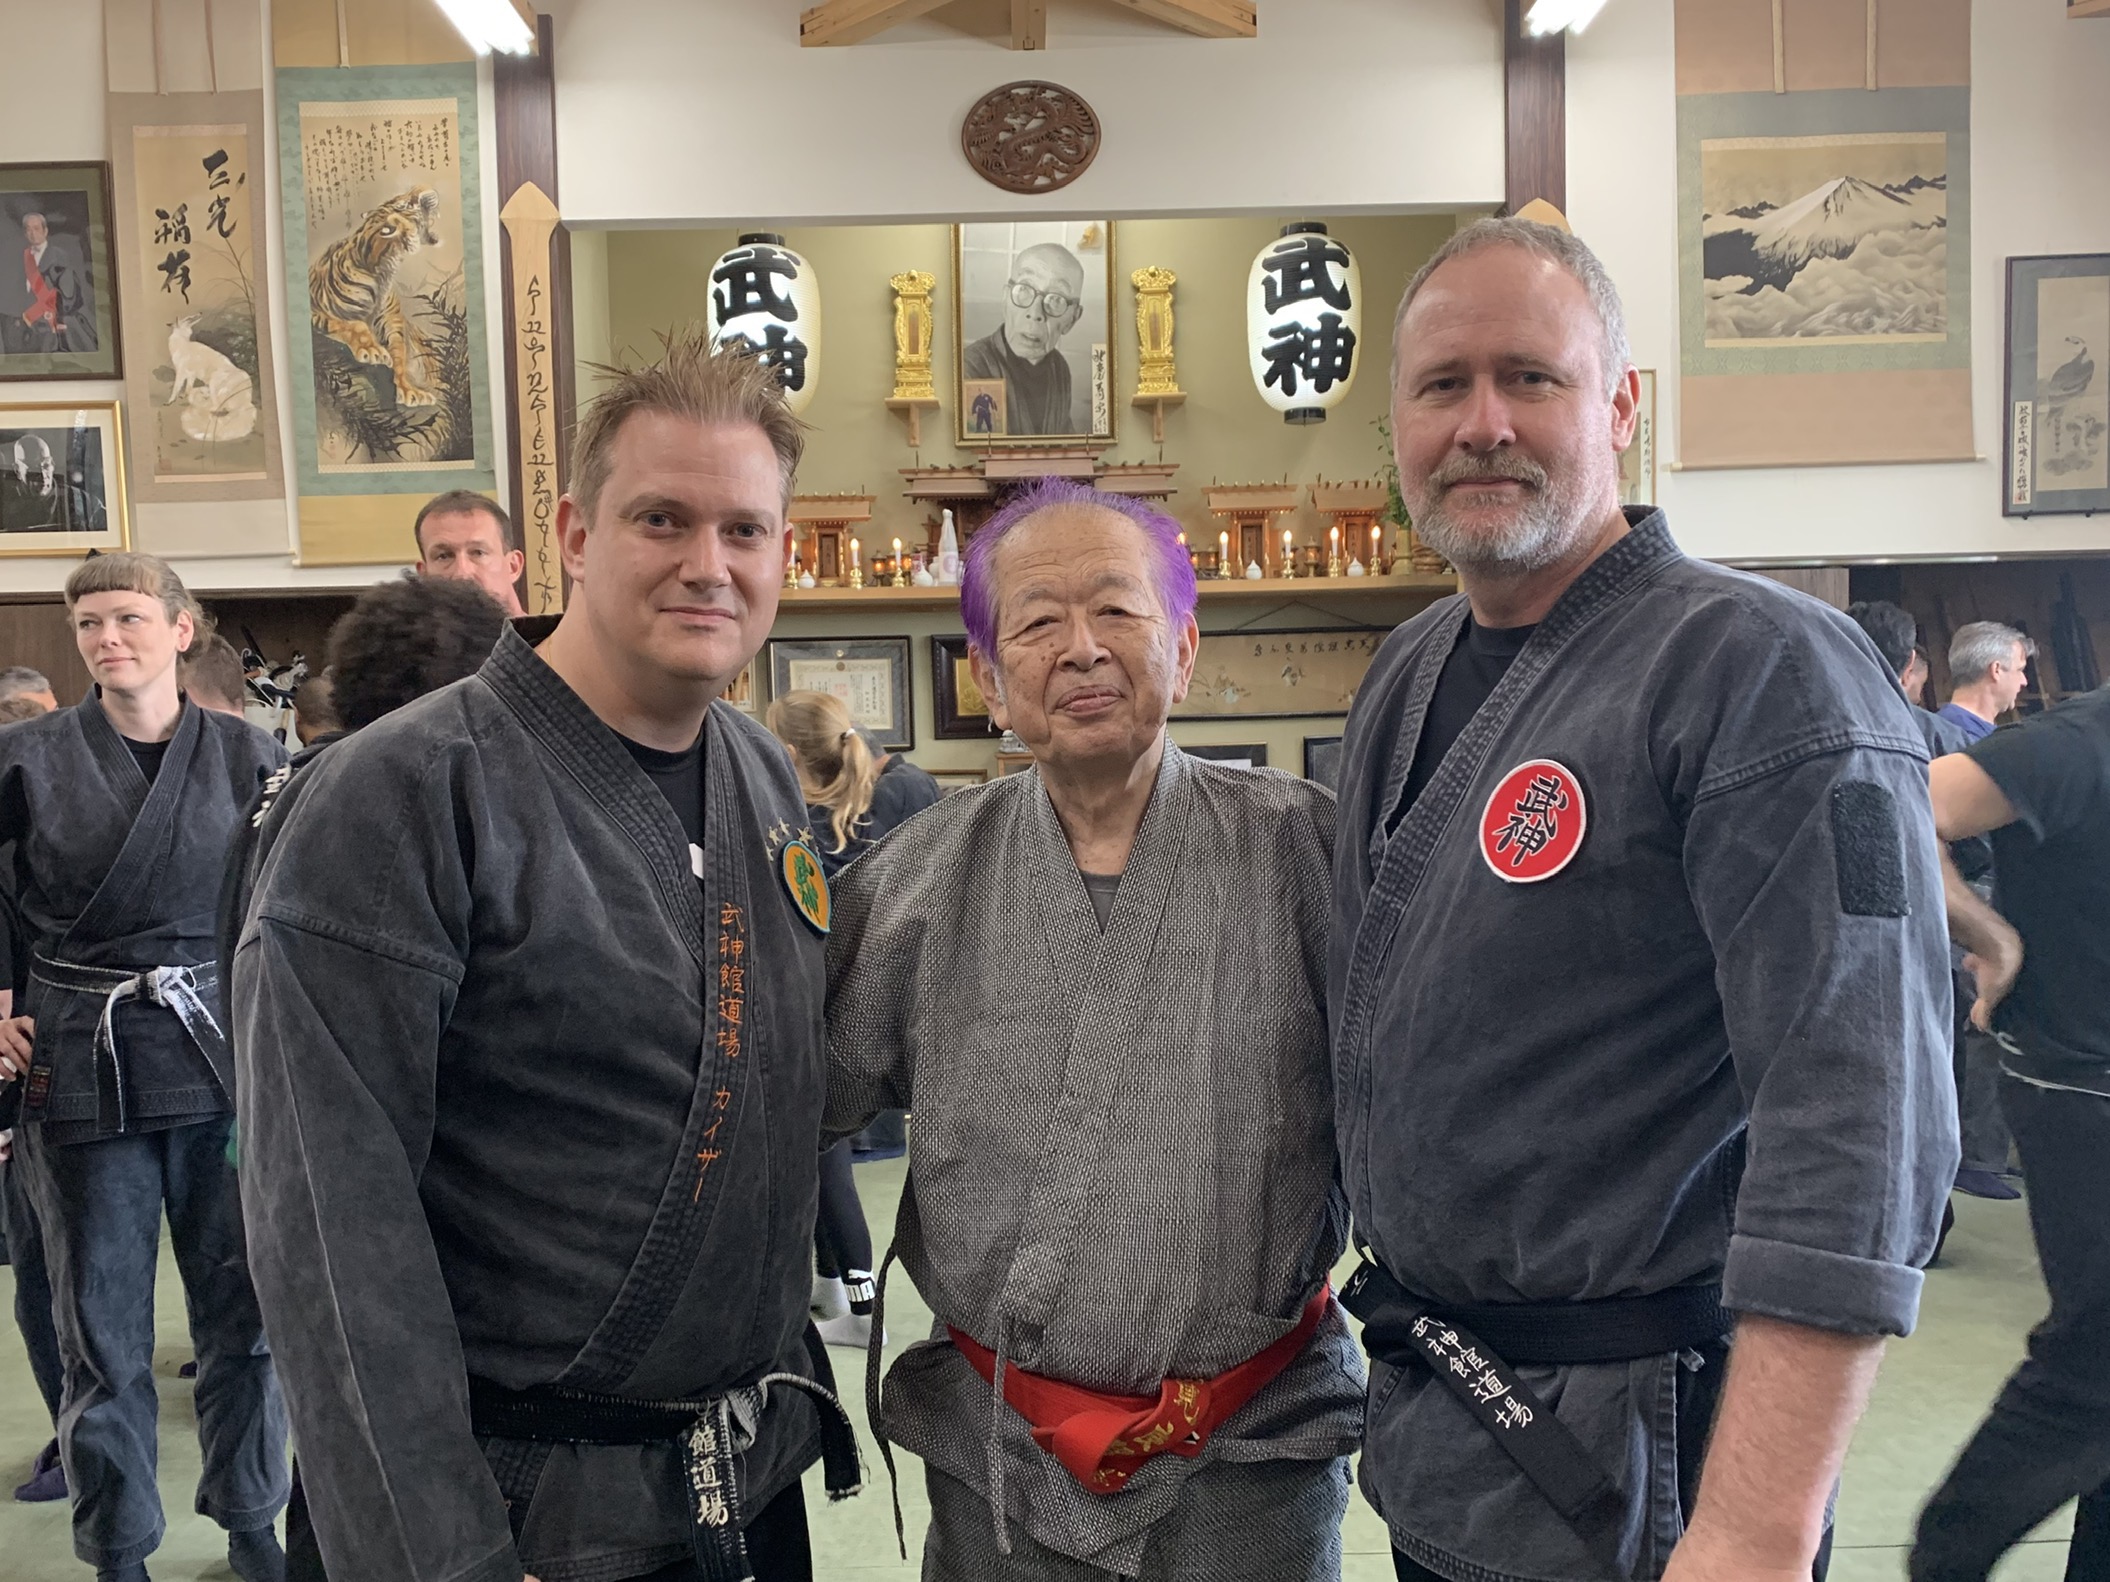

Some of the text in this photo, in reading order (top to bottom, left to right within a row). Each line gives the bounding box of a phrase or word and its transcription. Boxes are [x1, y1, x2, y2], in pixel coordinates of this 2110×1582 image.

[1261, 236, 1356, 396] 武神
[1492, 773, 1569, 867] 武神
[694, 902, 745, 1203] 武神館道場 カイザー
[1411, 1316, 1534, 1429] 武神館道場
